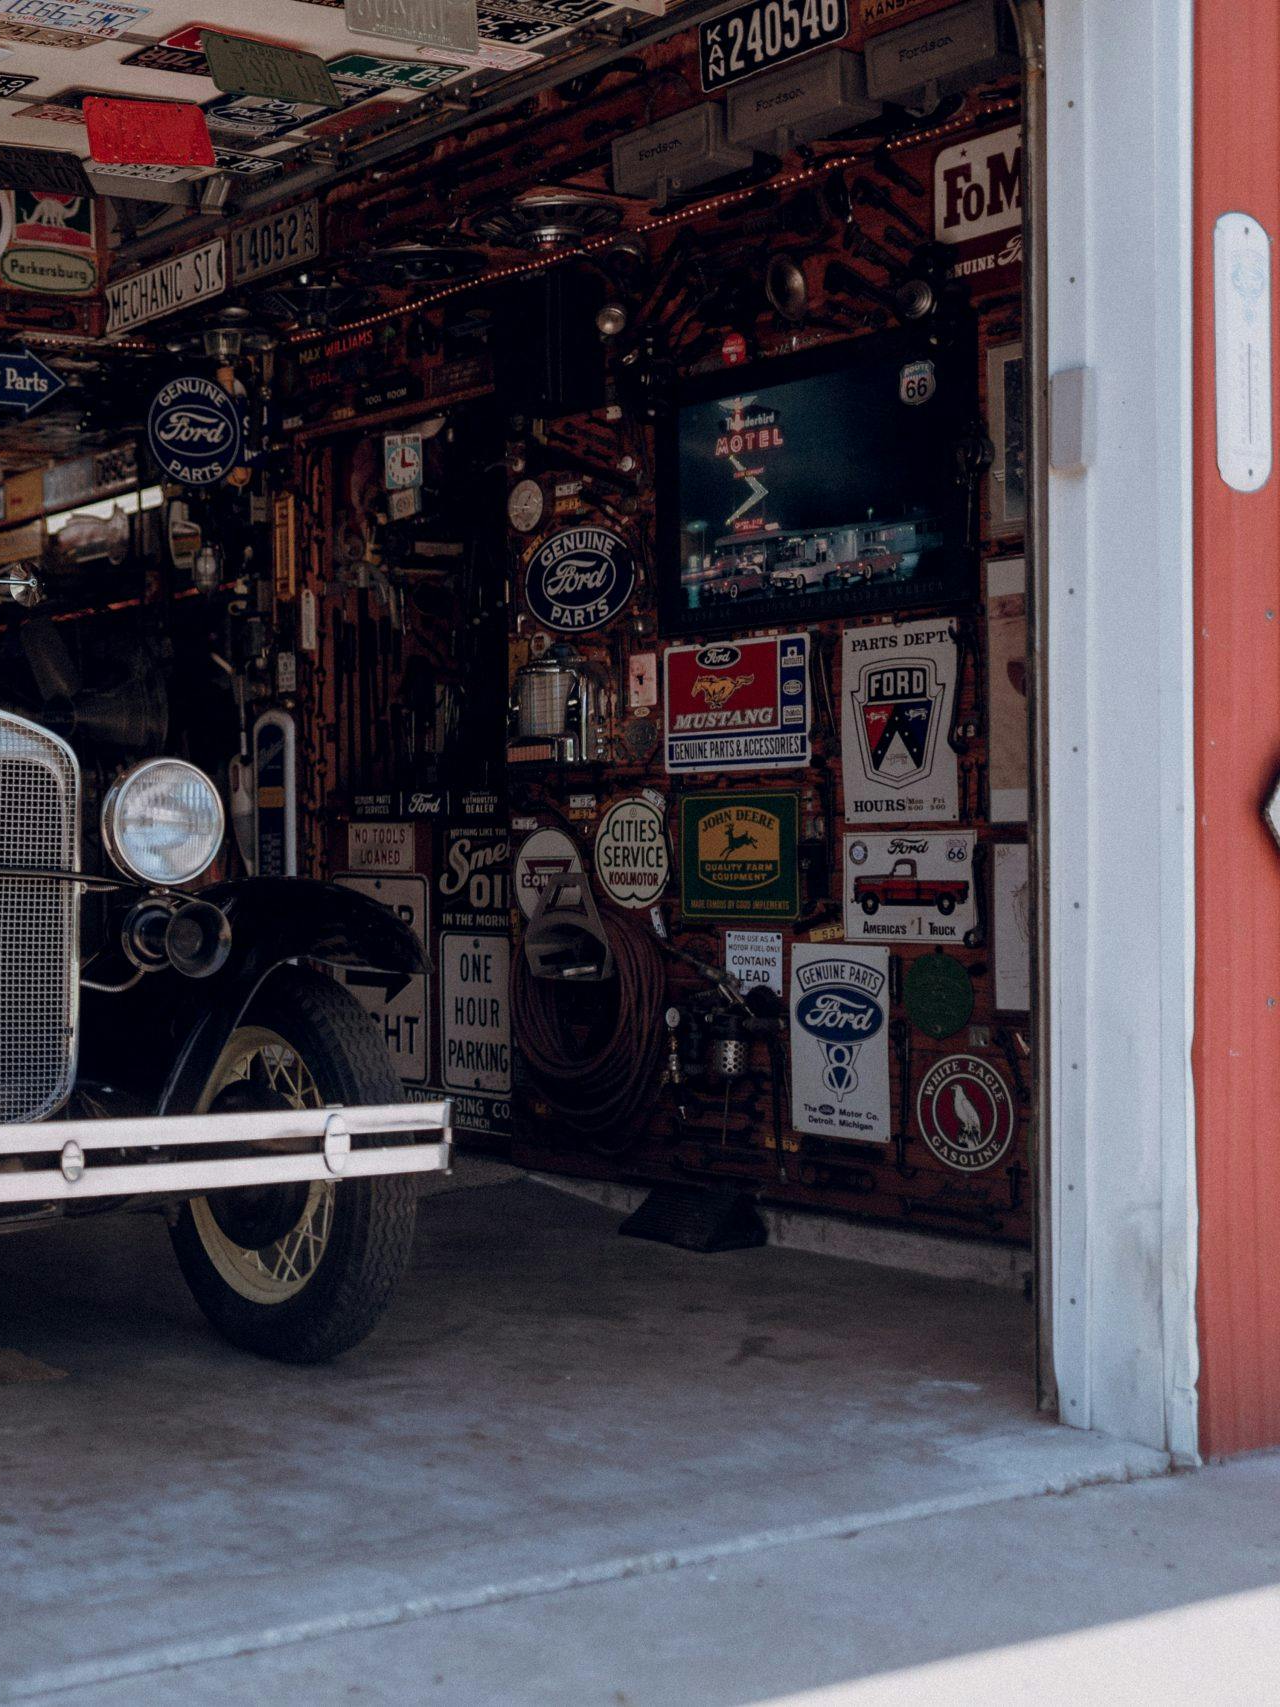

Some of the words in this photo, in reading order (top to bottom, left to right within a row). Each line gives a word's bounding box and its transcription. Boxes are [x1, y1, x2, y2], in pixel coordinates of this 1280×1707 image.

[705, 24, 726, 81] KAN
[899, 36, 954, 62] Fordson
[756, 87, 806, 114] Fordson
[638, 138, 682, 162] Fordson
[235, 218, 298, 277] 14052
[10, 259, 88, 283] Parkersburg
[110, 259, 183, 324] MECHANIC
[323, 328, 375, 359] WILLIAMS
[4, 368, 50, 394] Parts
[157, 376, 228, 408] GENUINE
[906, 376, 928, 399] 66
[158, 409, 226, 444] Ford
[715, 427, 784, 457] MOTEL
[168, 461, 223, 482] PARTS
[539, 530, 619, 566] GENUINE
[547, 559, 608, 595] Ford
[550, 598, 610, 627] PARTS
[851, 635, 899, 653] PARTS
[903, 630, 949, 648] DEPT.
[703, 647, 733, 664] Ford
[869, 669, 927, 698] FORD
[672, 706, 775, 730] MUSTANG
[674, 739, 709, 761] GENUINE
[709, 738, 735, 758] PARTS
[743, 734, 801, 756] ACCESSORIES
[408, 792, 442, 815] Ford
[465, 804, 496, 815] DEALER
[853, 798, 906, 814] HOURS
[611, 817, 658, 843] CITIES
[701, 811, 731, 833] JOHN
[733, 808, 775, 831] DEERE
[354, 828, 369, 845] NO
[372, 828, 407, 845] TOOLS
[887, 839, 930, 856] Ford
[360, 850, 402, 866] LOANED
[603, 845, 665, 870] SERVICE
[947, 846, 966, 861] 66
[608, 871, 660, 888] KOOLMOTOR
[704, 863, 744, 874] QUALITY
[746, 862, 774, 873] FARM
[710, 872, 770, 883] EQUIPMENT
[442, 912, 453, 926] IN
[454, 913, 474, 927] THE
[862, 921, 908, 935] AMERICA'S
[928, 922, 957, 937] TRUCK
[460, 952, 493, 985] ONE
[731, 955, 778, 967] CONTAINS
[738, 968, 771, 983] LEAD
[801, 963, 847, 987] GENUINE
[847, 966, 881, 991] PARTS
[454, 996, 500, 1029] HOUR
[805, 994, 874, 1031] Ford
[448, 1039, 509, 1074] PARKING
[923, 1059, 961, 1098] WHITE
[967, 1058, 1008, 1104] EAGLE
[803, 1104, 818, 1114] The
[838, 1107, 864, 1120] Motor
[866, 1111, 880, 1122] Co.
[838, 1118, 875, 1132] Michigan
[930, 1134, 1003, 1166] GASOLINE
